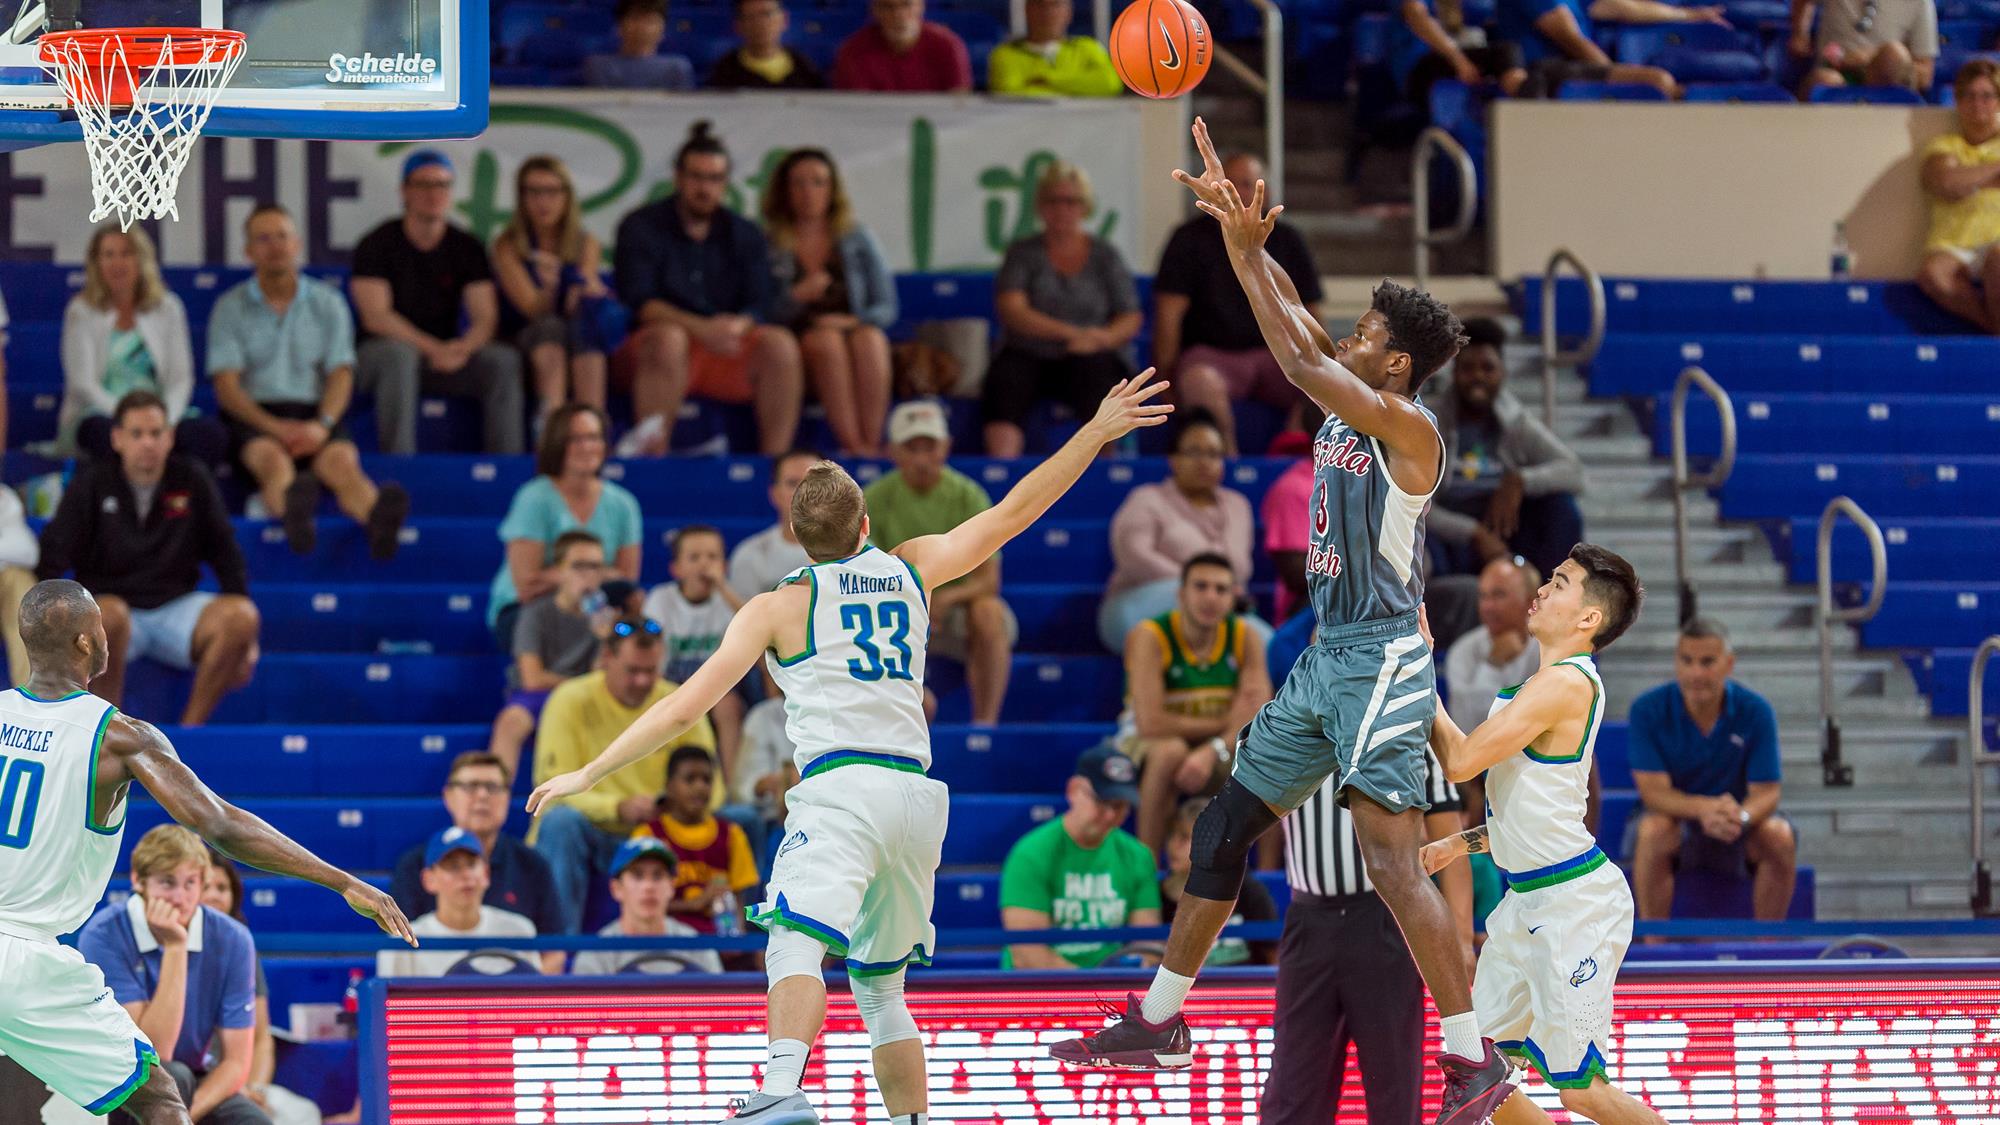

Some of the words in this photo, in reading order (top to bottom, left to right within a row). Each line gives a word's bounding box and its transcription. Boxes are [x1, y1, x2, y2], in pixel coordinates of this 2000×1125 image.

[325, 53, 437, 83] Schelde
[343, 72, 433, 83] international
[1315, 479, 1329, 537] 3
[839, 573, 903, 595] MAHONEY
[840, 600, 914, 682] 33
[0, 723, 53, 752] MICKLE
[0, 754, 45, 850] 0
